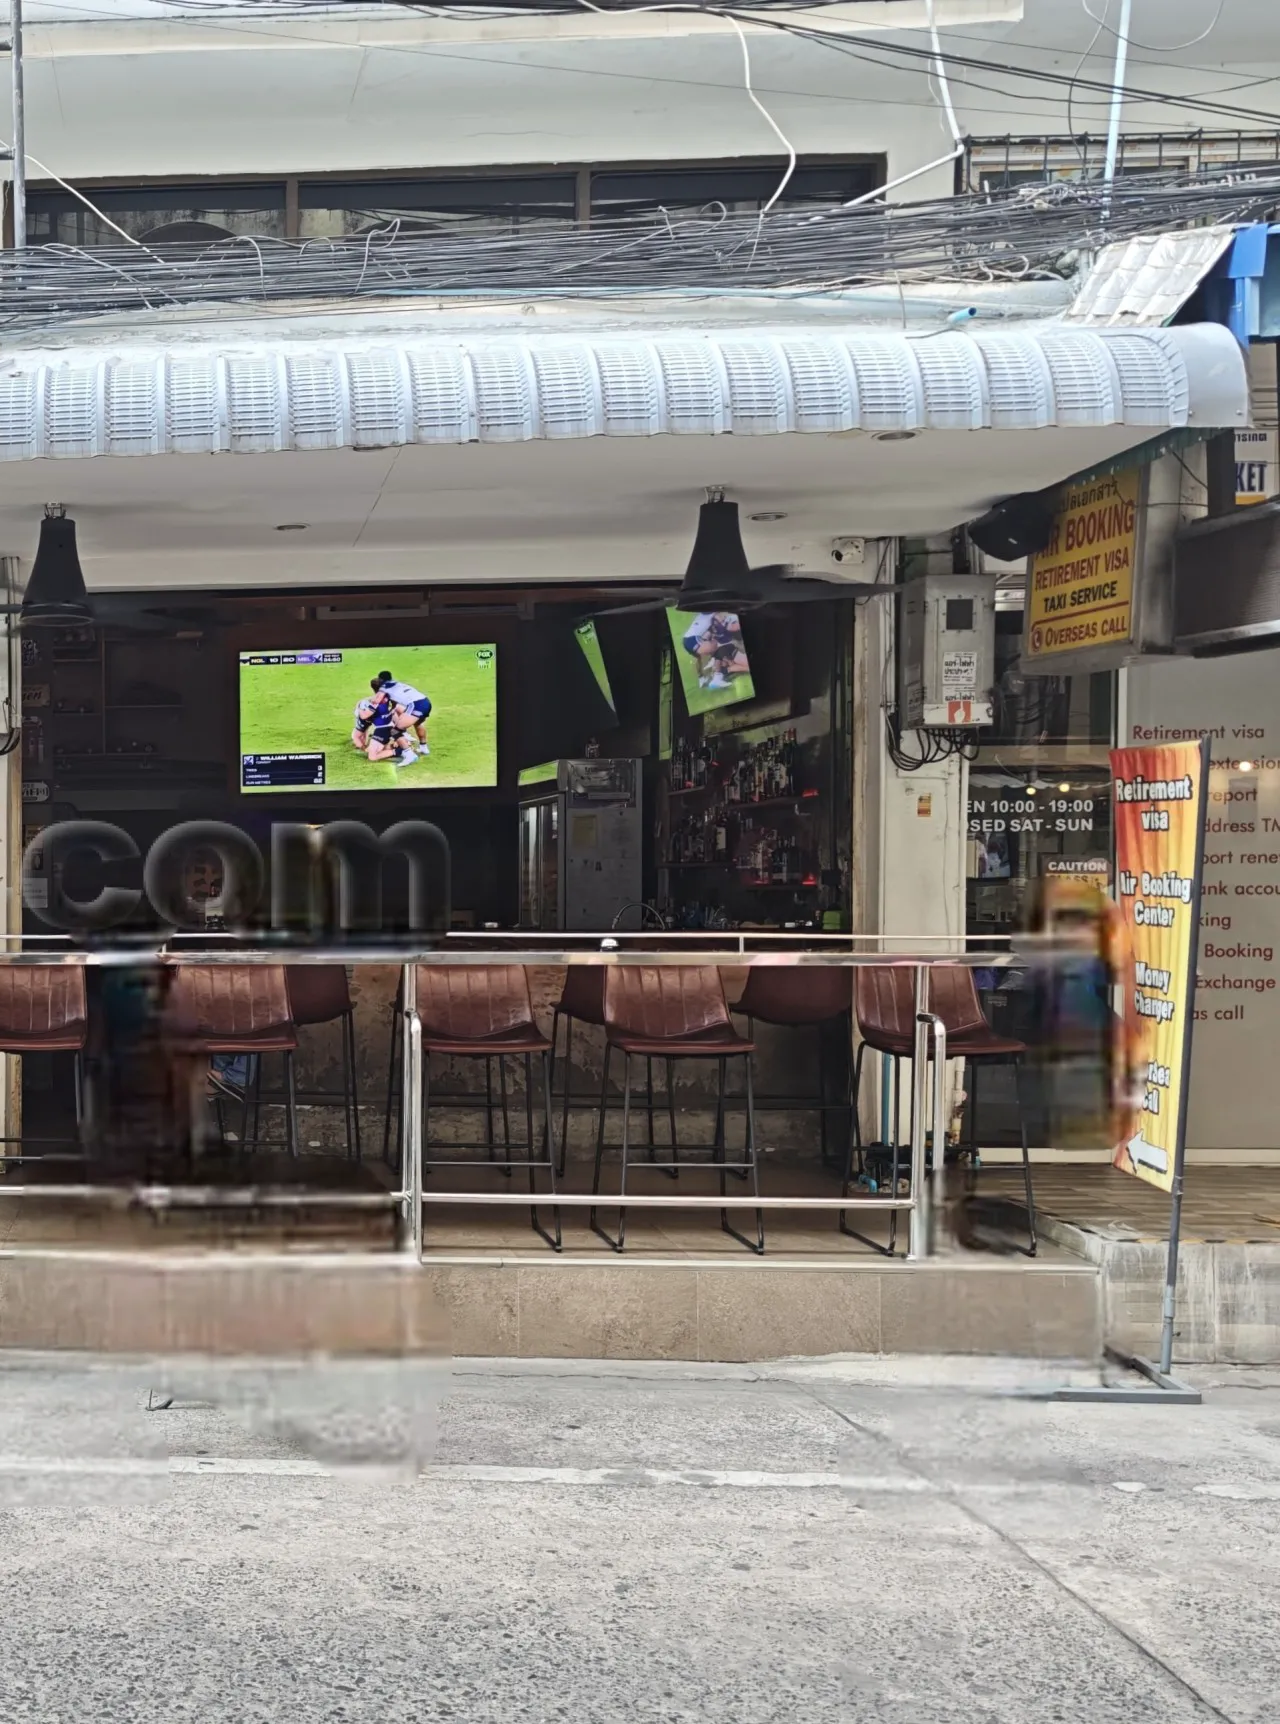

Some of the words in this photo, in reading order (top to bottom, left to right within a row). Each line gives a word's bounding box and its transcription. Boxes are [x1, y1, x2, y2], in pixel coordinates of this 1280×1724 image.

[1036, 522, 1060, 559] IR
[1065, 503, 1134, 552] BOOKING
[1035, 554, 1101, 592] RETIREMENT
[1104, 546, 1129, 573] VISA
[1043, 593, 1067, 613] TAXI
[1070, 580, 1118, 608] SERVICE
[1101, 615, 1127, 636] CALL
[1132, 724, 1226, 740] Retirement
[1232, 724, 1265, 739] visa
[1209, 755, 1280, 770] extesio
[1114, 774, 1192, 802] Retirement
[990, 799, 1035, 813] 10:00
[1048, 799, 1094, 813] 19:00
[967, 819, 1006, 832] SED
[1010, 819, 1044, 832] SAT
[1055, 818, 1094, 832] SUN
[1140, 805, 1170, 831] visa
[1048, 861, 1107, 871] CAUTION
[1240, 853, 1280, 865] rene
[1141, 870, 1192, 903] Booking
[1134, 900, 1175, 927] Center
[1204, 943, 1274, 961] Booking
[1135, 961, 1171, 994] Money
[1134, 988, 1175, 1024] Changer
[1214, 1005, 1245, 1020] call
